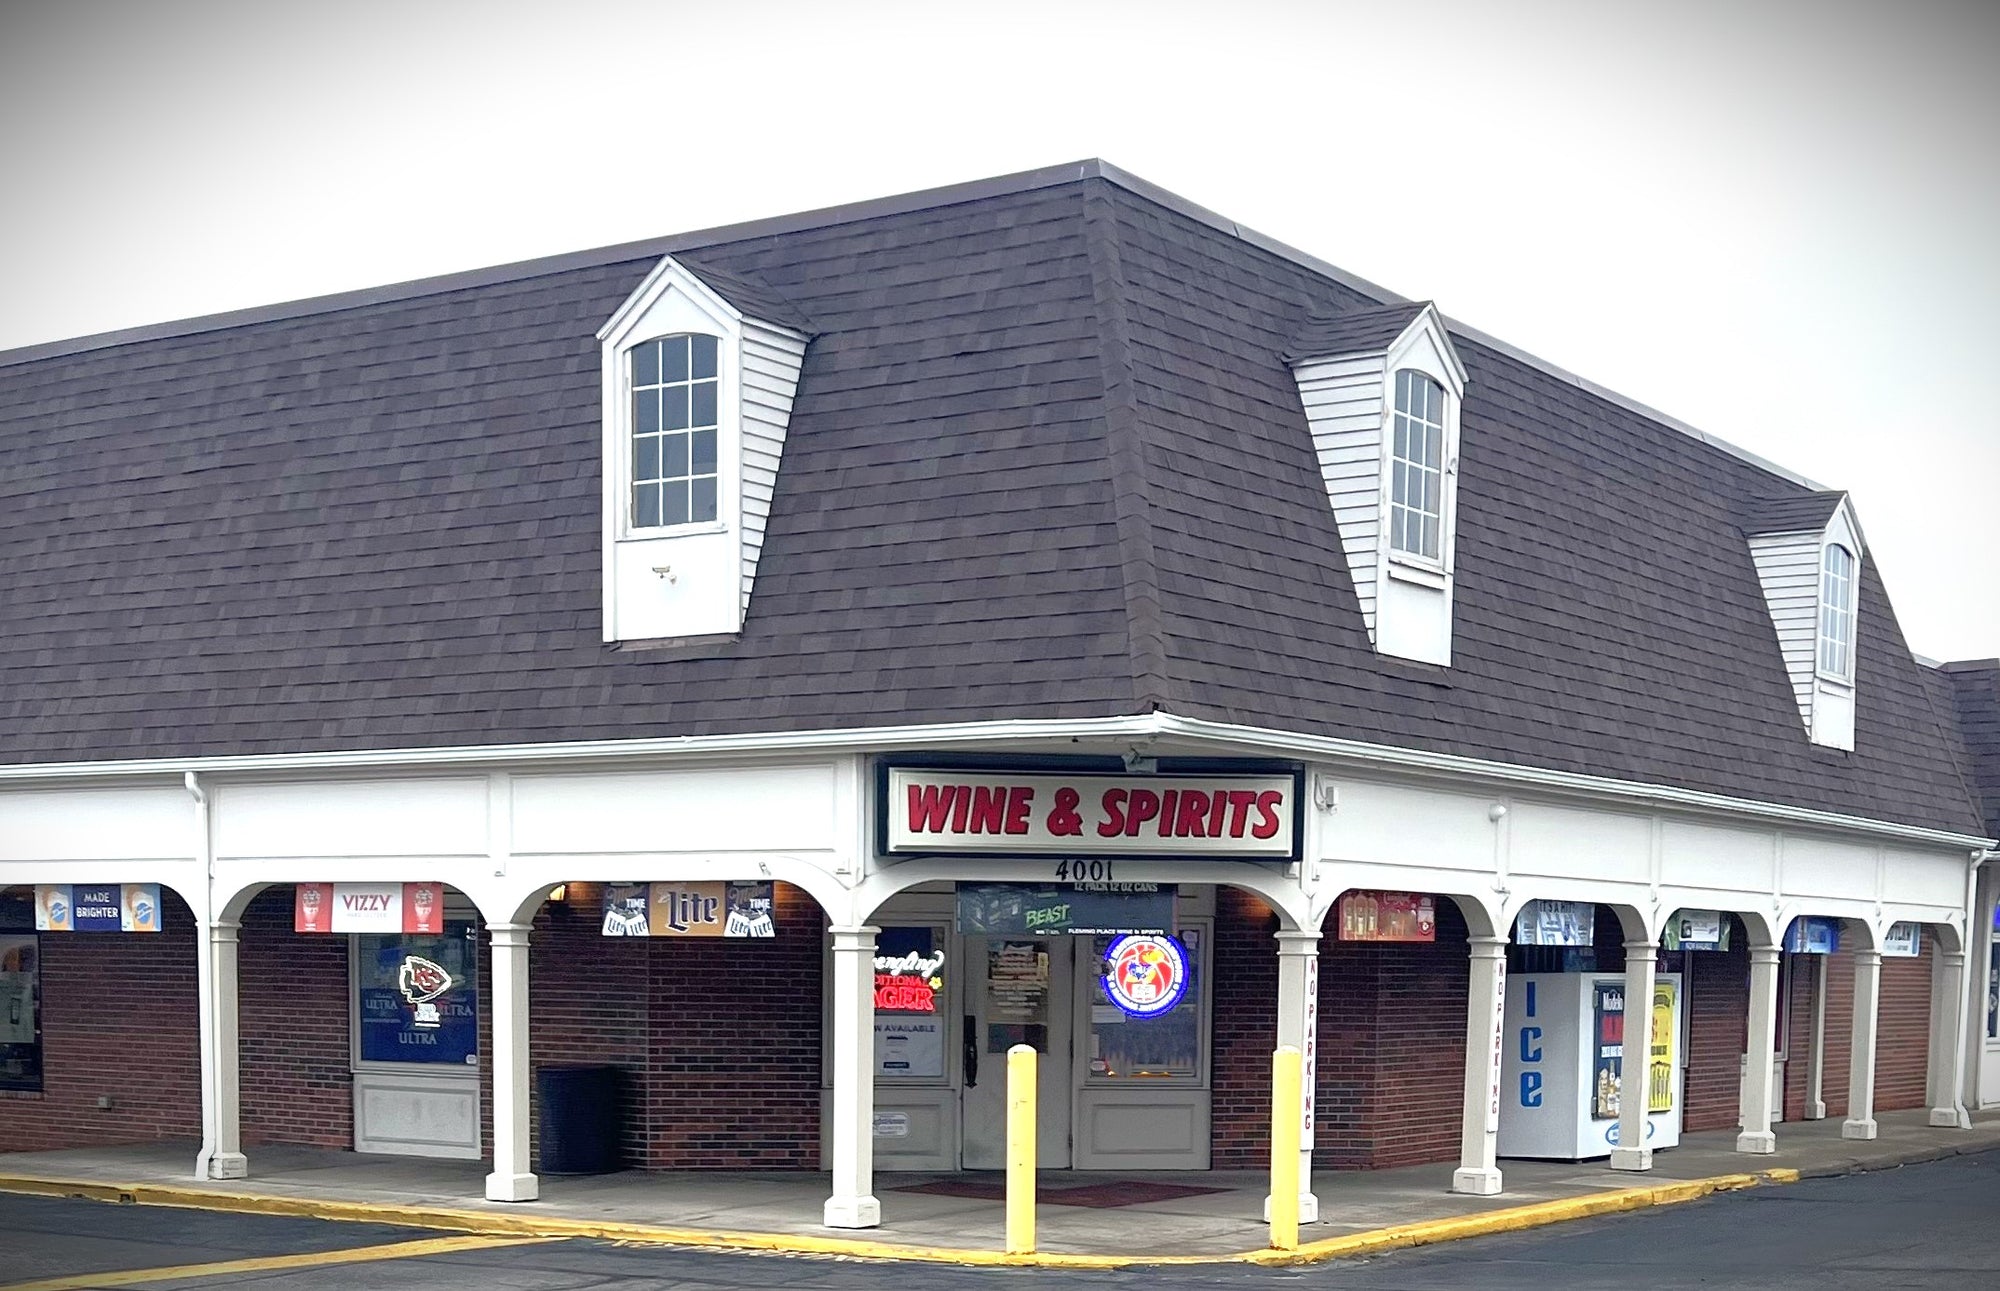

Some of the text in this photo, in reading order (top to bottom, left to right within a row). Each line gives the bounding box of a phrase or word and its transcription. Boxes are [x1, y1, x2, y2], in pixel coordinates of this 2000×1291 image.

[908, 784, 1284, 840] WINE & SPIRITS
[1055, 860, 1113, 881] 4001
[83, 892, 110, 903] MADE
[342, 894, 392, 911] VIZZY
[76, 907, 119, 918] BRIGHTER
[656, 890, 718, 933] Lite
[1026, 904, 1070, 928] BEAST
[873, 951, 944, 977] engling
[874, 975, 930, 987] DITIONAL
[366, 1000, 398, 1010] ULTRA
[874, 987, 935, 1012] AGER
[398, 1033, 438, 1045] ULTRA
[1304, 959, 1315, 1130] NO PARKING
[1491, 1003, 1503, 1114] PARKING
